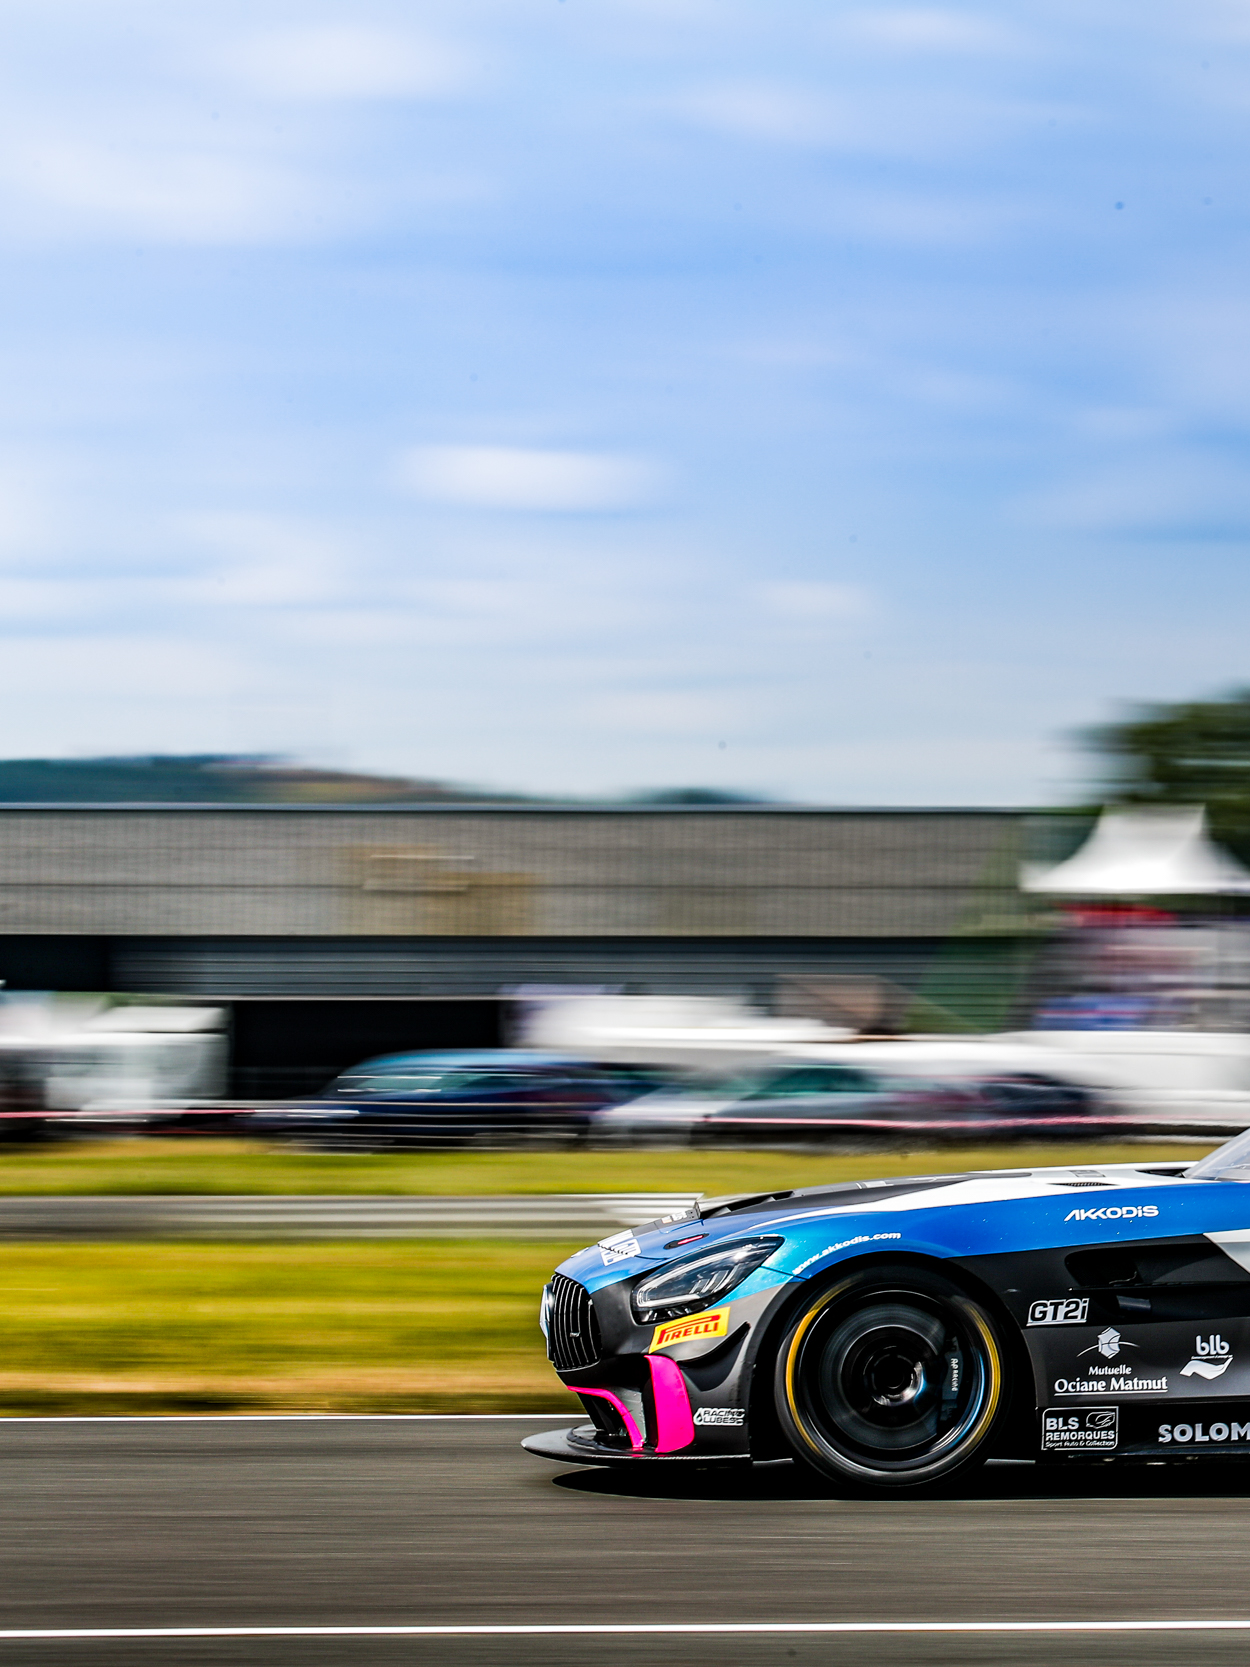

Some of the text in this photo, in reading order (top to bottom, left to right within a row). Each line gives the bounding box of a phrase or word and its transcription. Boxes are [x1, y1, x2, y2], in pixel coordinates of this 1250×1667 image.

[792, 1232, 902, 1275] www.akkodis.com
[657, 1314, 721, 1345] PIRELLI
[1195, 1334, 1230, 1356] blb
[1088, 1364, 1132, 1376] Mutuelle
[1054, 1376, 1168, 1393] Ociane Matmut
[1046, 1417, 1080, 1430] BLS
[1045, 1430, 1115, 1441] REMORQUES
